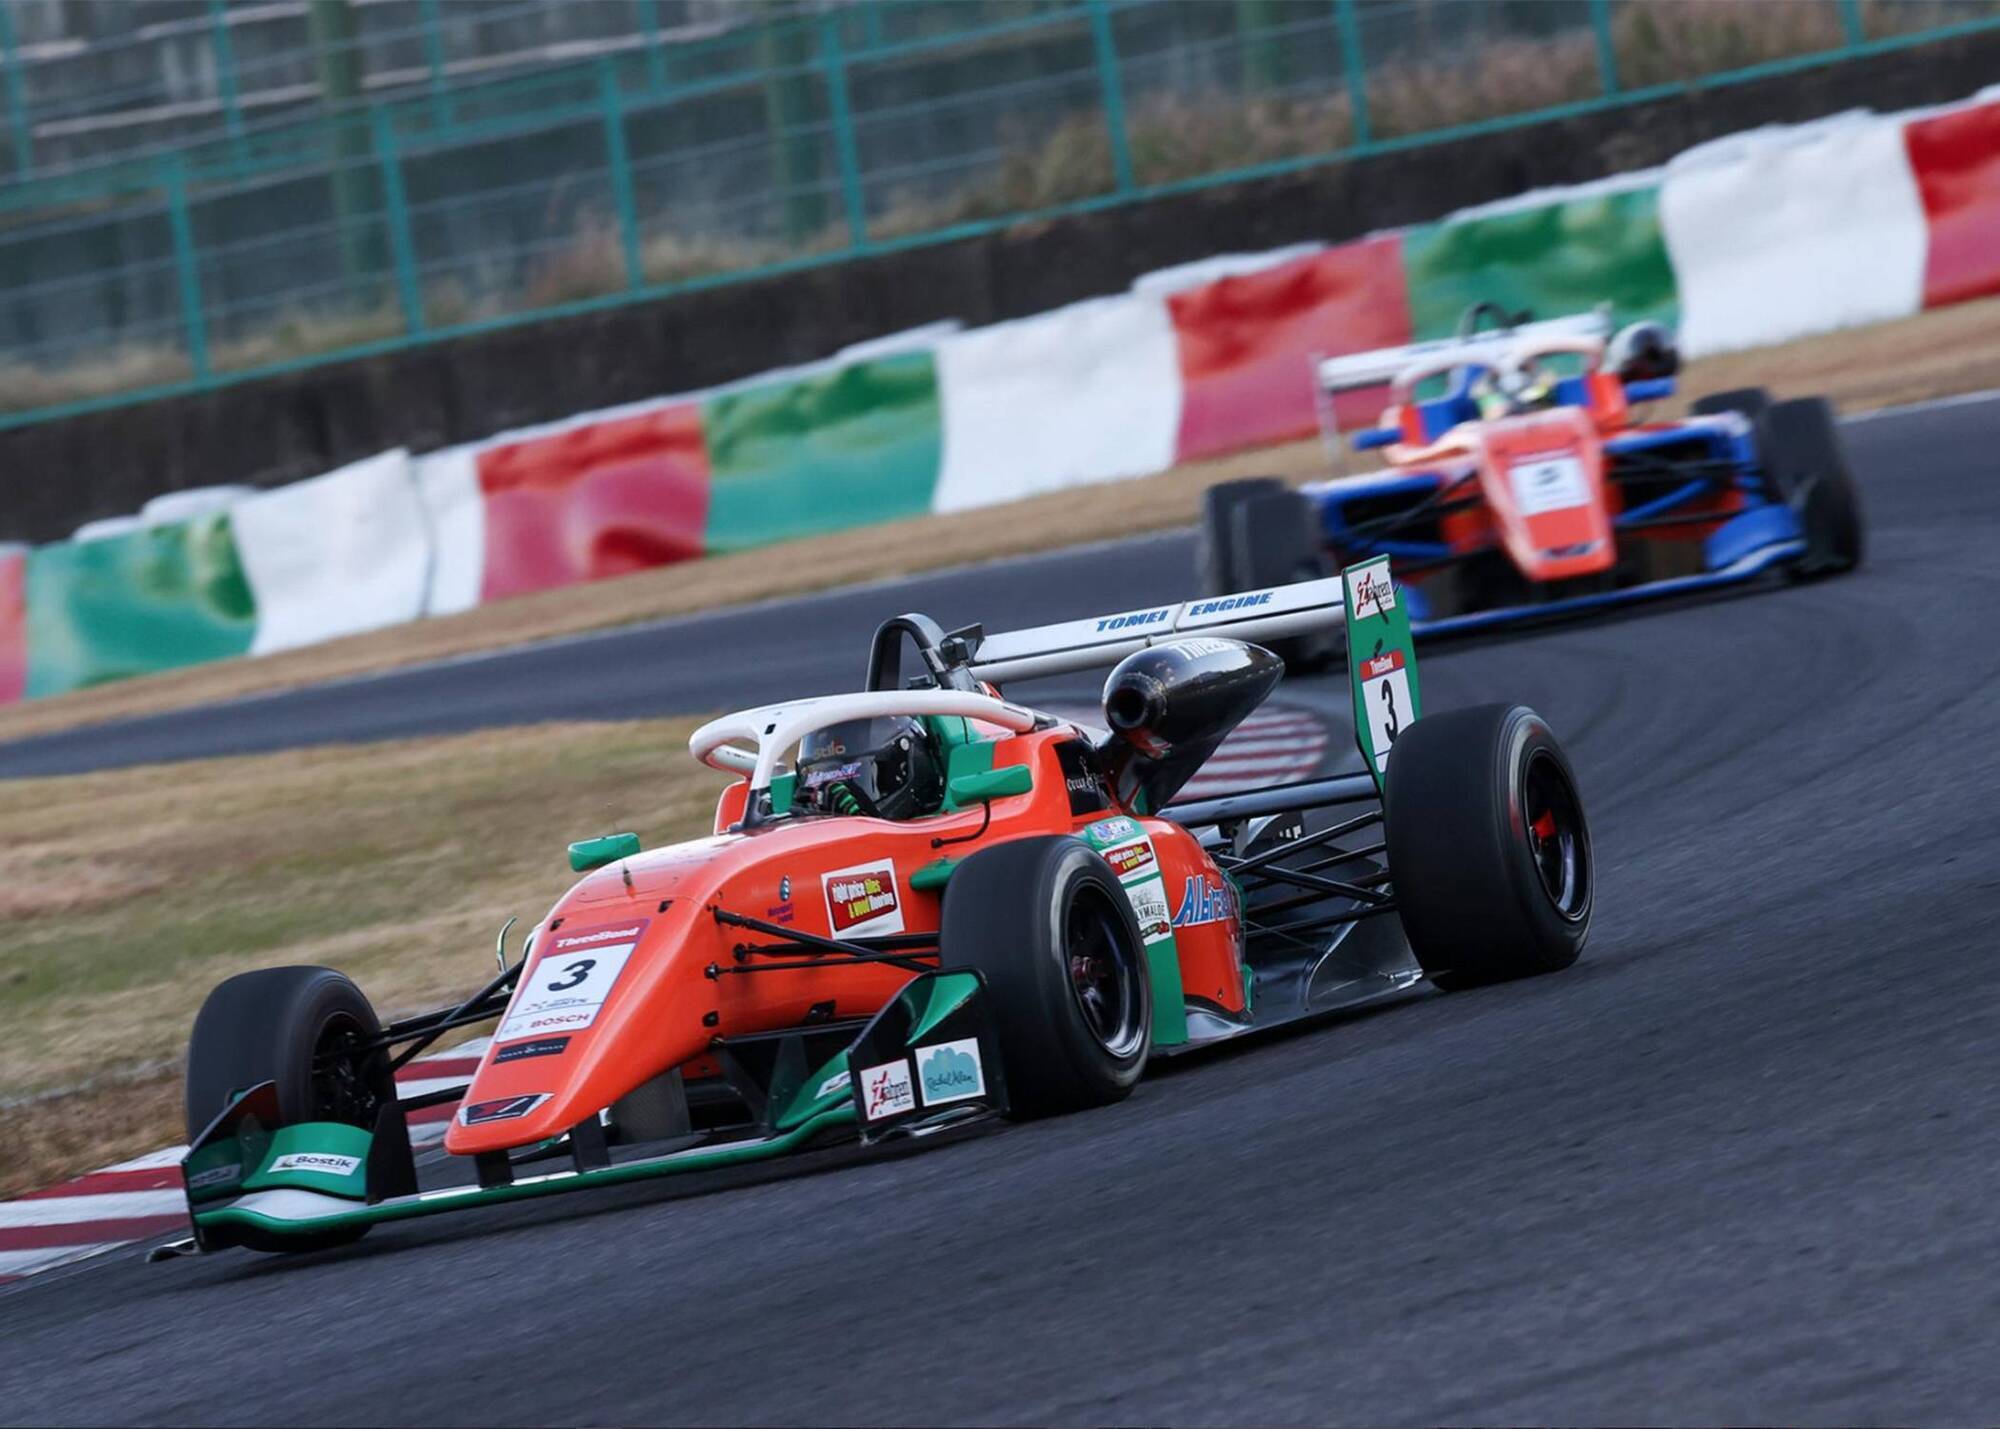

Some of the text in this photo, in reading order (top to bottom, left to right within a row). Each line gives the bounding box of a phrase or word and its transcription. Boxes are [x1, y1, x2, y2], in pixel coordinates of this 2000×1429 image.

[1096, 592, 1274, 632] TOMEI ENGINE
[1381, 679, 1398, 743] 3
[1136, 904, 1165, 920] YMALOE
[556, 927, 640, 948] ThreeBond
[547, 959, 596, 992] 3
[530, 1013, 590, 1029] BOSCH
[295, 1155, 352, 1168] Bostik
